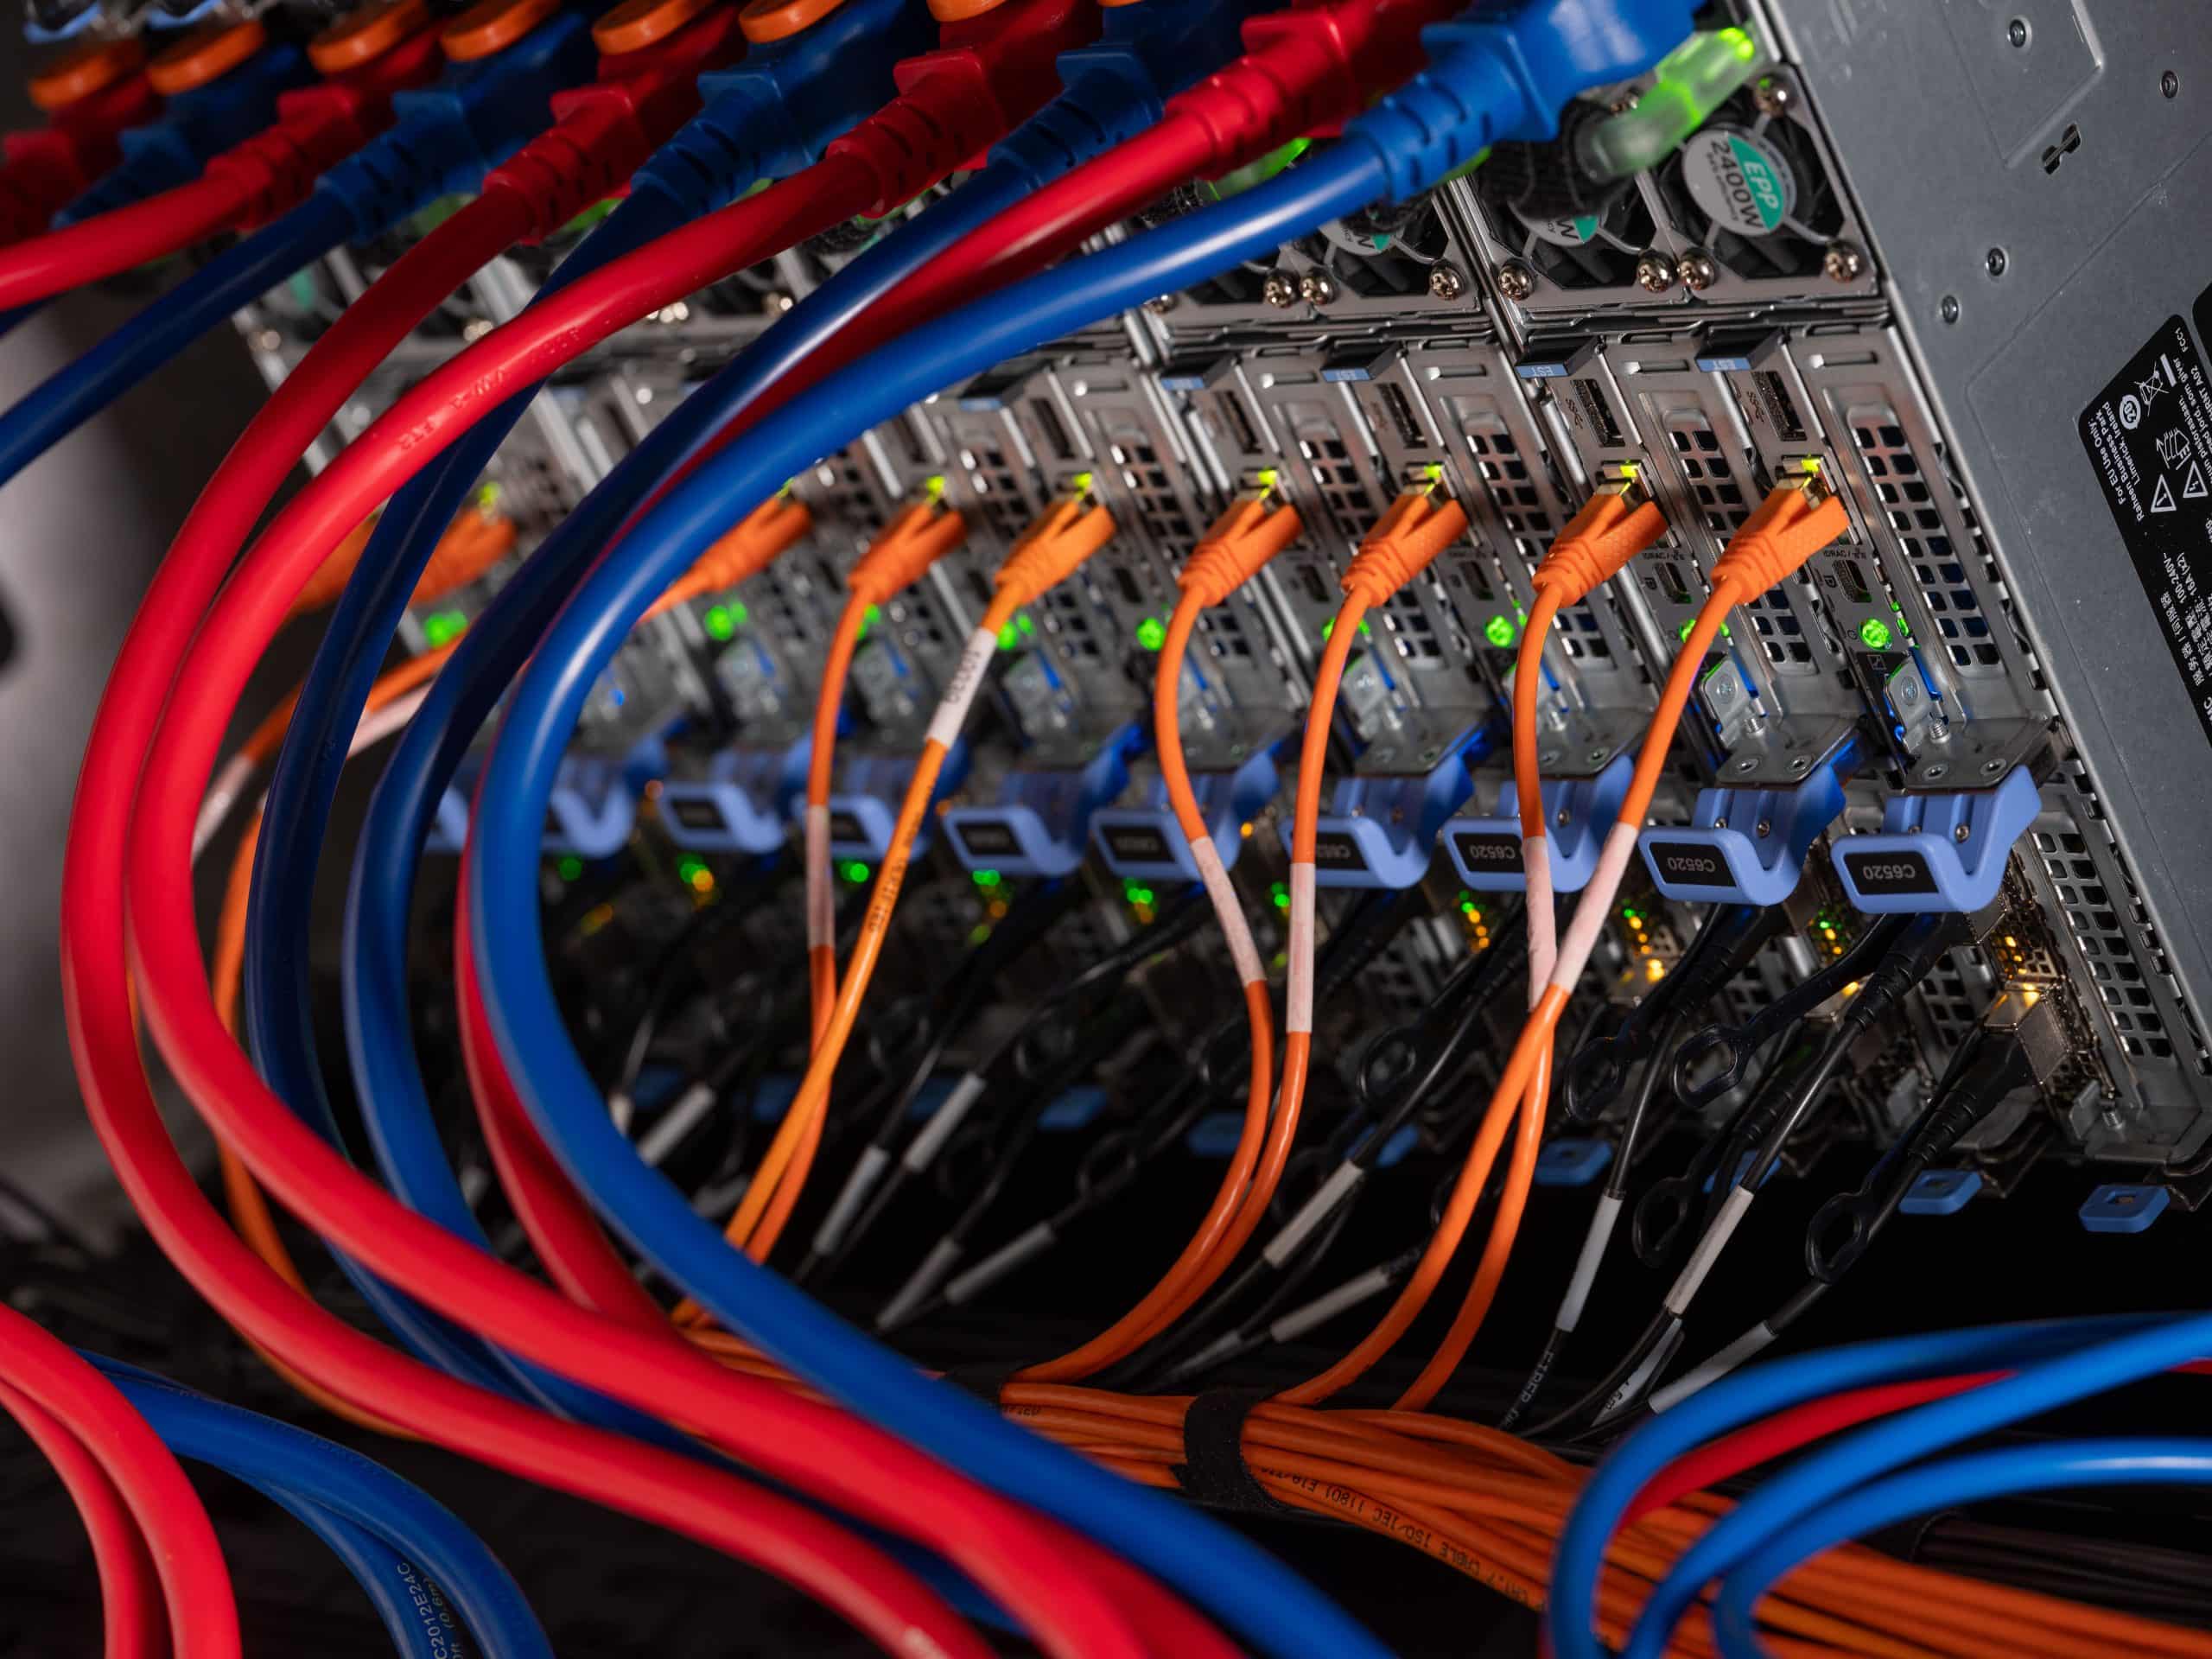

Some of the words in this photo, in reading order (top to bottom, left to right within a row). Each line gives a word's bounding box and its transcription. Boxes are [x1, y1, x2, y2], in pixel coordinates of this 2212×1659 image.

[1711, 140, 1766, 228] 2400W
[1744, 162, 1779, 209] EPP
[2175, 327, 2189, 353] FCC1
[1529, 365, 1554, 377] EST
[2190, 365, 2204, 386] A02
[2123, 404, 2138, 423] 20
[2198, 387, 2212, 422] HRNT
[2088, 418, 2102, 448] Only:
[2095, 409, 2109, 436] Park
[2101, 401, 2121, 439] Ireland
[2100, 447, 2112, 470] Use
[2106, 434, 2129, 483] Business
[2119, 435, 2140, 486] Limerick,
[2107, 468, 2119, 486] EU
[2114, 485, 2126, 505] For
[2126, 480, 2145, 522] Raheen
[1468, 844, 1517, 861] C6520
[1667, 856, 1716, 873] C6520
[1863, 864, 1916, 880] C6520
